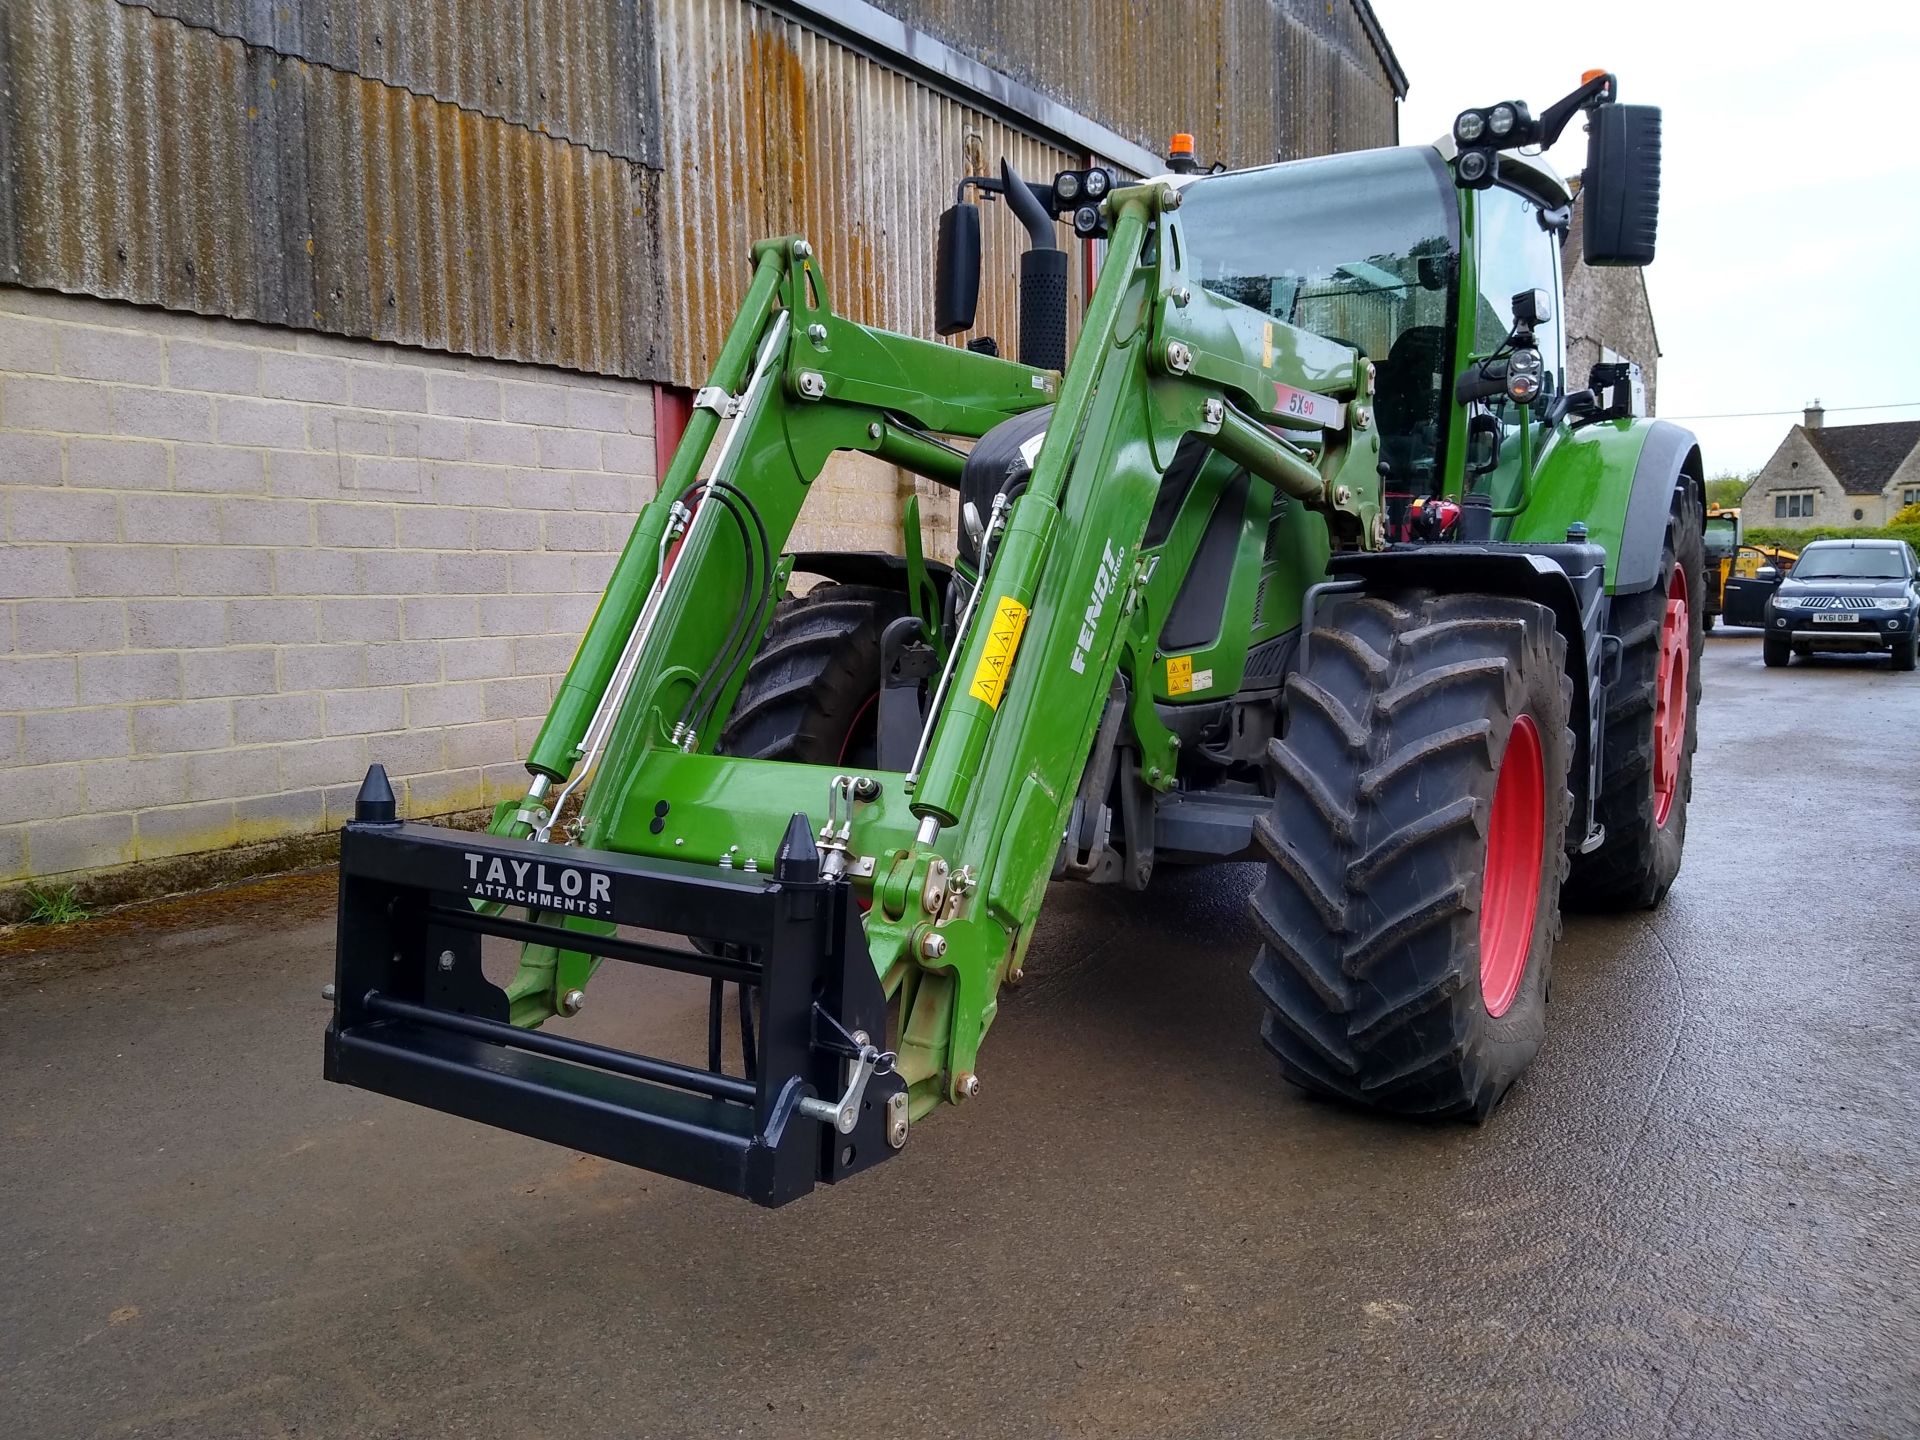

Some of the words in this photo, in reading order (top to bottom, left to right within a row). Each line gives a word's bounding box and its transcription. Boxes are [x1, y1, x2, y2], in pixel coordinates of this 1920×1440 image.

[1108, 546, 1125, 595] CARGO
[1070, 537, 1116, 675] FENDT
[464, 853, 611, 902] TAYLOR
[474, 882, 598, 915] ATTACHMENTS
